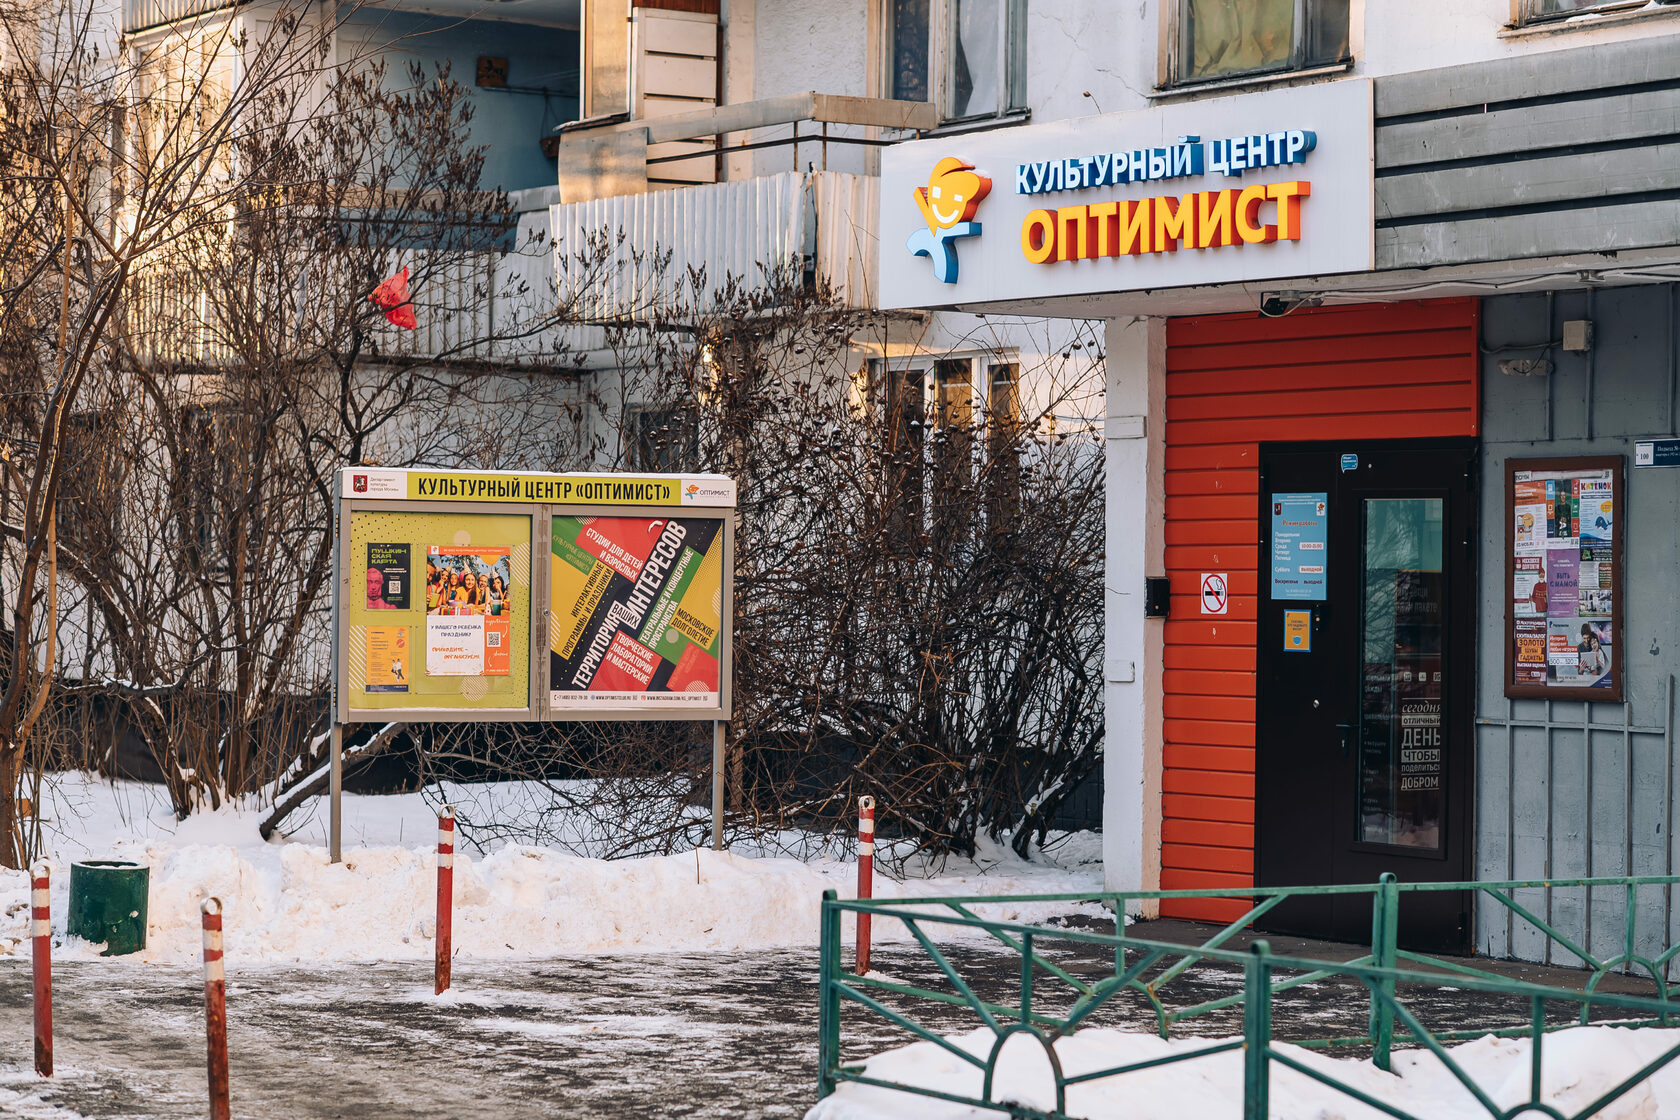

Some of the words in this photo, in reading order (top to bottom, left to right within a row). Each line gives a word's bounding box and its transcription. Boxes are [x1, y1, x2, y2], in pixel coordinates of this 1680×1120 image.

[1015, 136, 1203, 195] КУЛЬТУРНЫЙ
[1208, 130, 1316, 177] ЦЕНТР
[1020, 181, 1310, 265] ОПТИМИСТ
[418, 477, 521, 498] КУЛЬТУРНЫЙ
[524, 482, 573, 501] ЦЕНТР
[575, 482, 671, 501] «ОПТИМИСТ»
[586, 527, 612, 550] СТУДИИ
[609, 543, 624, 558] ДЛЯ
[622, 552, 644, 570] ДЕТЕЙ
[599, 550, 607, 560] И
[605, 554, 638, 580] ВЗРОСЛЫХ
[626, 520, 687, 621] ИНТЕРЕСОВ
[666, 548, 694, 593] КОНЦЕРТНЫЕ
[570, 563, 605, 618] ИНТЕРАКТИВНЫЕ
[587, 567, 613, 610] ПРАЗДНИКИ
[663, 591, 672, 599] И
[1554, 579, 1578, 587] МАМОЙ
[584, 605, 592, 615] И
[611, 603, 640, 629] ВАШИХ
[640, 596, 669, 644] ТЕАТРАЛЬНЫЕ
[648, 600, 679, 650] ПРОСТРАНСТВА
[676, 607, 715, 638] МОСКОВСКОЕ
[561, 613, 589, 657] ПРОГРАММЫ
[616, 632, 654, 663] ТВОРЧЕСКИЕ
[671, 617, 710, 647] ДОЛГОЛЕТИЕ
[1519, 639, 1545, 647] ЗОЛОТО
[571, 612, 622, 690] ТЕРРИТОРИЯ
[611, 642, 654, 675] ЛАБОРАТОРИИ
[606, 651, 614, 662] И
[611, 656, 650, 686] МАСТЕРСКИЕ
[1402, 700, 1440, 713] сегодня
[1403, 715, 1440, 725] отличный
[1401, 728, 1440, 749] ДЕНЬ
[1404, 751, 1440, 761] ЧТОБЫ
[1401, 777, 1439, 790] ДОБРОМ
